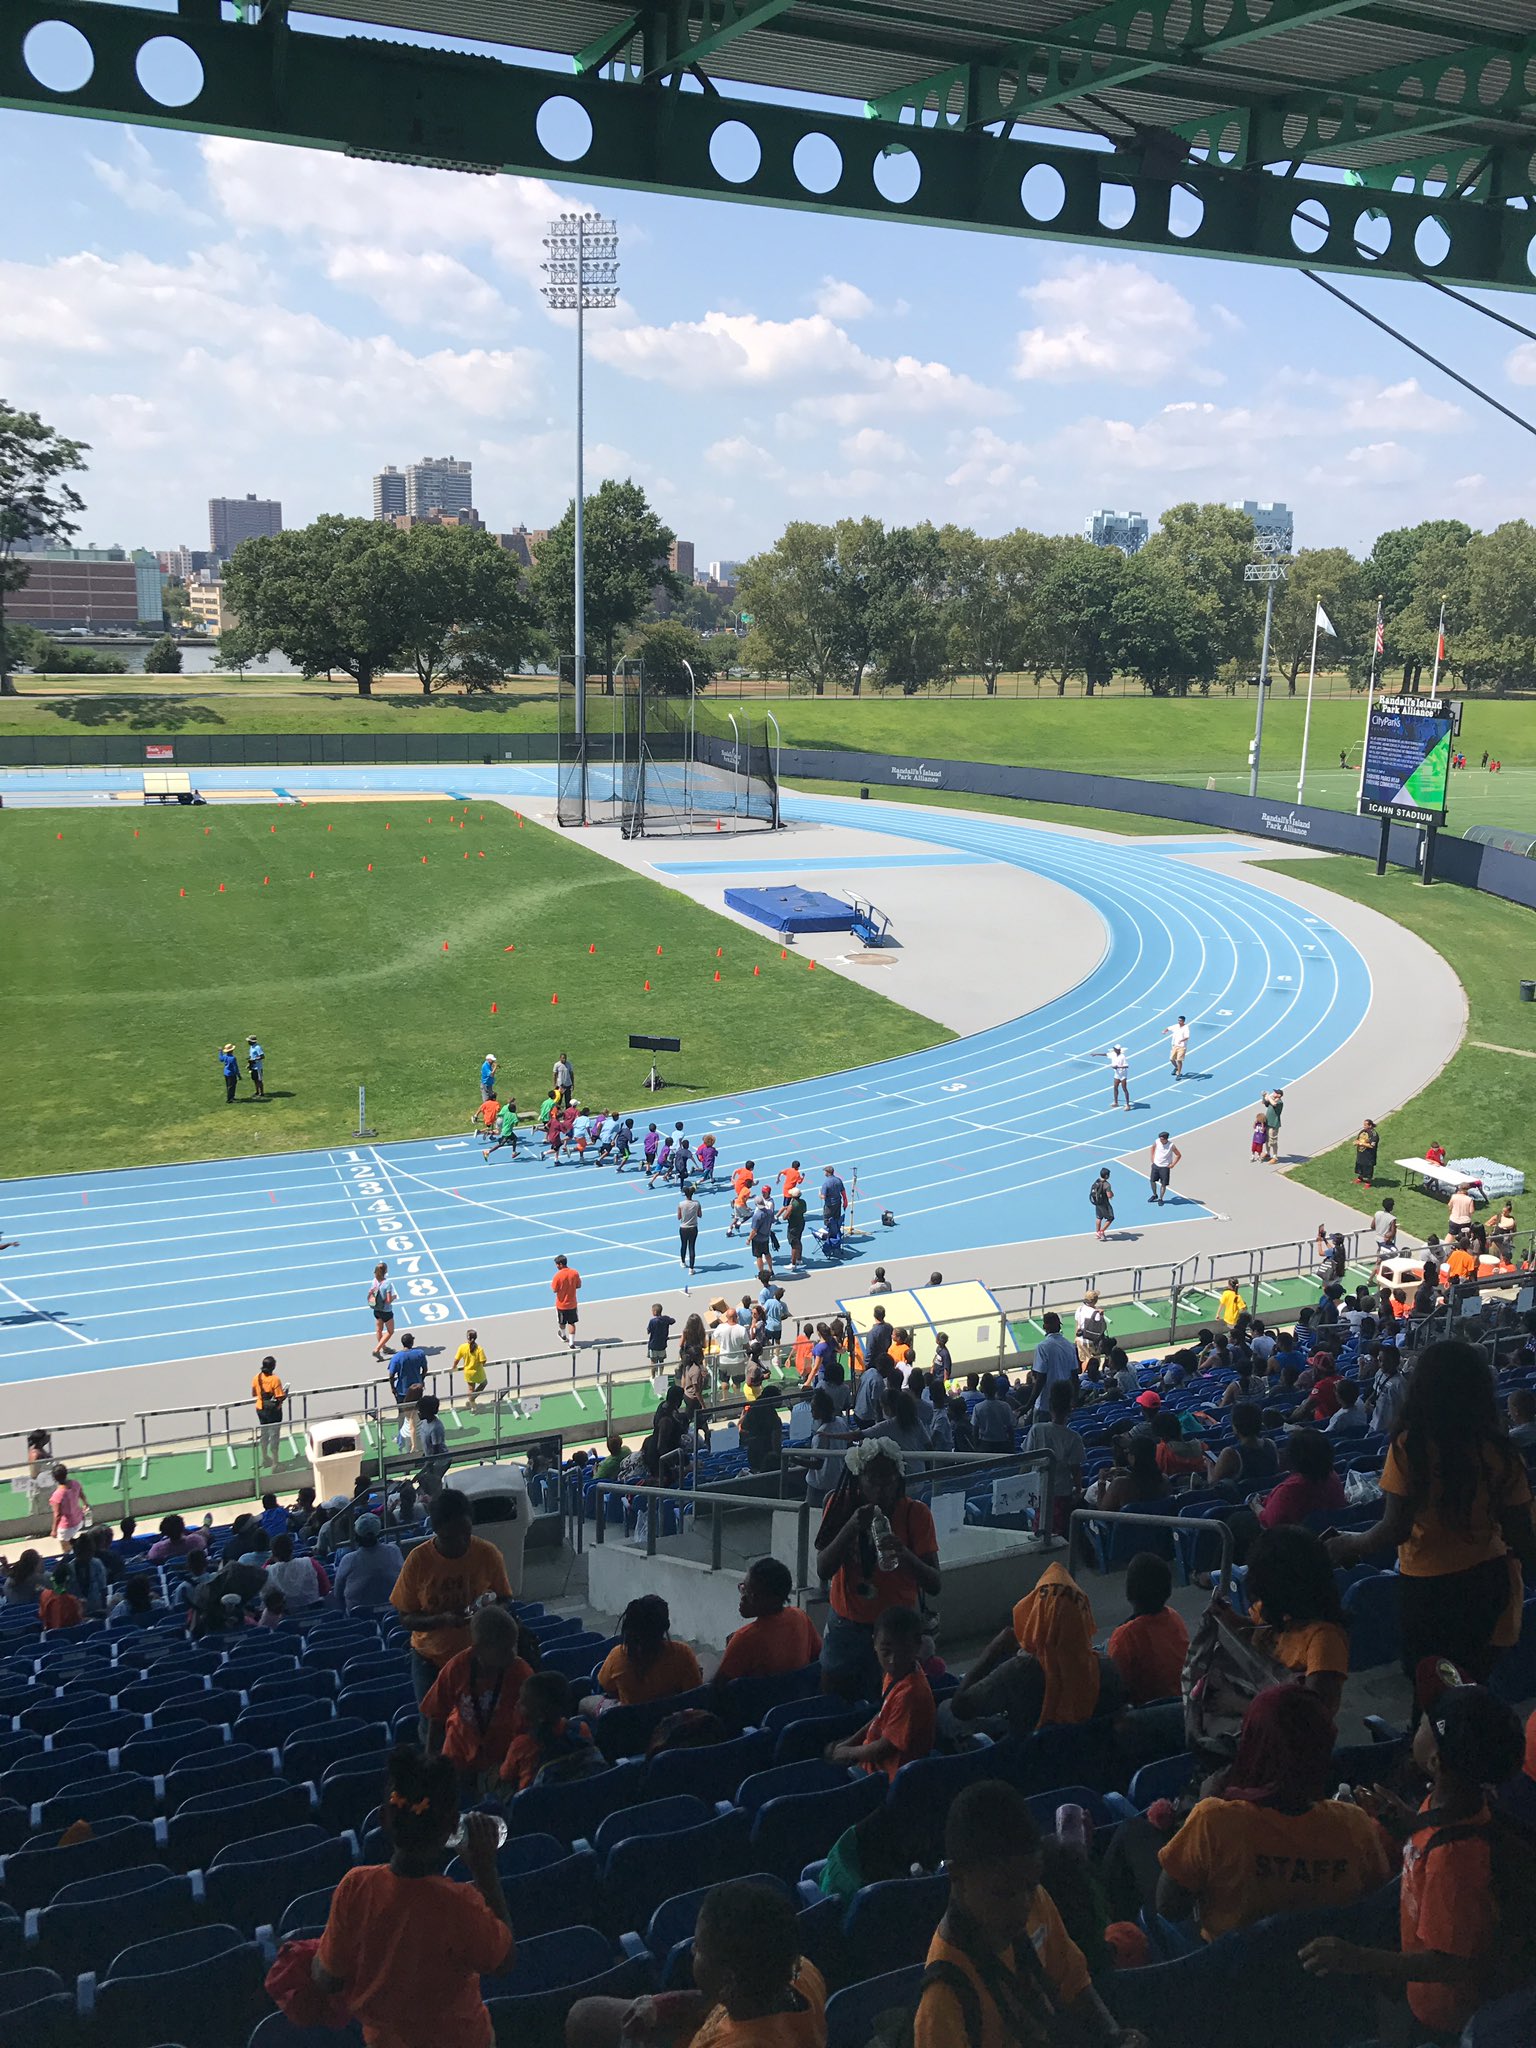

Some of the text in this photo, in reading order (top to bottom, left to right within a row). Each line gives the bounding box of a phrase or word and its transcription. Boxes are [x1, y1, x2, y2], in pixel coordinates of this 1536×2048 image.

[1379, 695, 1443, 709] Randall's Island
[1382, 704, 1434, 717] Park Alliance
[913, 775, 939, 783] Alliance
[923, 769, 942, 777] Island
[1368, 803, 1433, 822] ICAHN STADIUM
[1266, 821, 1308, 836] Park Alliance
[1292, 818, 1311, 829] Island
[940, 1082, 968, 1093] 3
[708, 1117, 741, 1127] 2
[434, 1140, 470, 1151] 1
[341, 1150, 367, 1163] 1
[350, 1165, 376, 1179] 2
[358, 1181, 384, 1195] 3
[367, 1199, 396, 1213] 4
[376, 1216, 403, 1232] 5
[386, 1235, 414, 1251] 6
[397, 1255, 422, 1273] 7
[407, 1278, 439, 1296] 8
[419, 1302, 449, 1322] 9
[1255, 1854, 1348, 1884] STAFF
